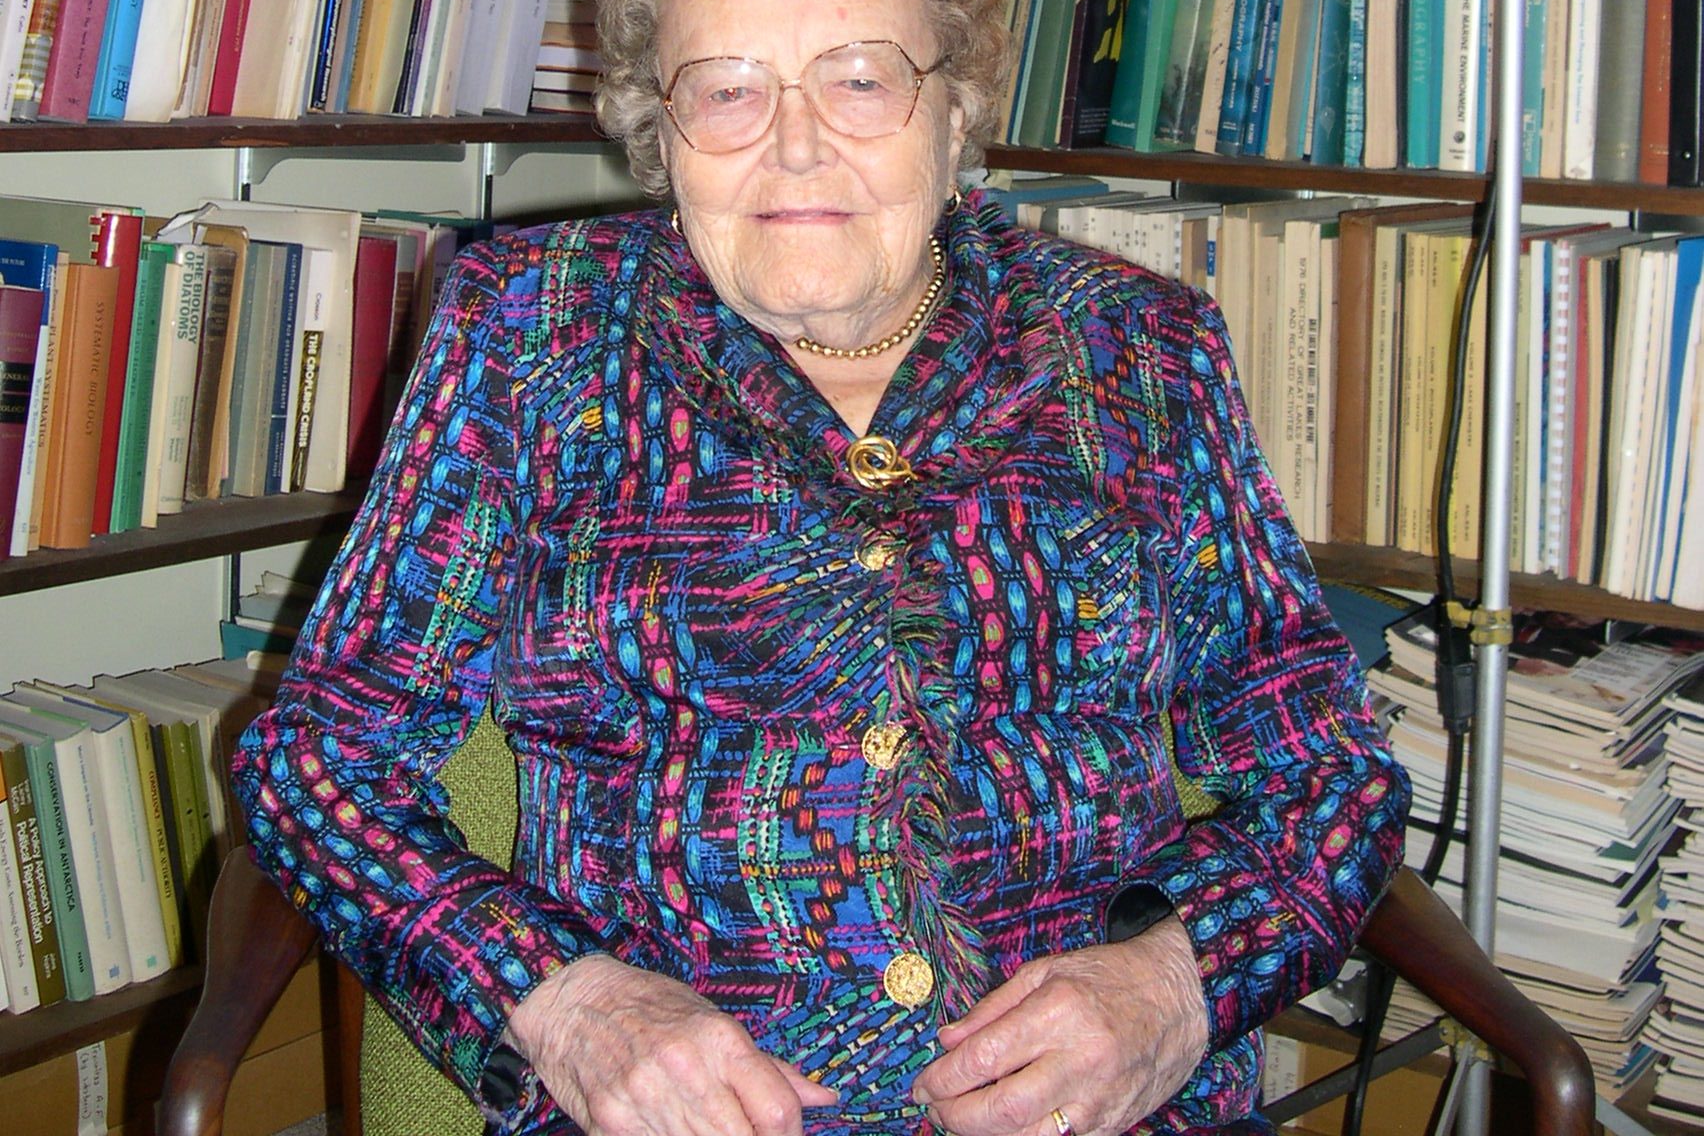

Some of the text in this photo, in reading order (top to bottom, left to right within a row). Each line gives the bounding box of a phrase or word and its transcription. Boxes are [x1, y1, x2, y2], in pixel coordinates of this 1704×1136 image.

[1460, 14, 1470, 51] MARINE
[319, 67, 331, 102] Research
[1456, 55, 1469, 123] ENVIRONMENT
[177, 251, 195, 340] OF DIATOMS
[187, 252, 205, 345] THE BIOLOGY
[286, 293, 294, 322] WRITING
[1297, 282, 1307, 340] DIRECTORY
[38, 325, 58, 448] PLANT SYSTEMATICS
[84, 302, 106, 438] SYSTEMATIC BIOLOGY
[282, 339, 290, 374] GRADUATE
[1286, 307, 1297, 441] AND RELATED ACTIVITIES
[1295, 365, 1305, 401] GREAT
[1297, 346, 1305, 361] OF
[298, 334, 318, 448] THE CROPLAND CRISIS
[1294, 404, 1304, 440] LAKES
[1465, 406, 1473, 448] CHEMISTRY
[1293, 443, 1303, 500] RESEARCH
[46, 761, 76, 913] CONSERVATION IN ANTARCTICA
[148, 771, 161, 820] COMPLIANCE
[160, 856, 172, 900] AUTHORITY
[16, 821, 43, 944] Political Representation
[27, 817, 52, 924] A Policy Approach to
